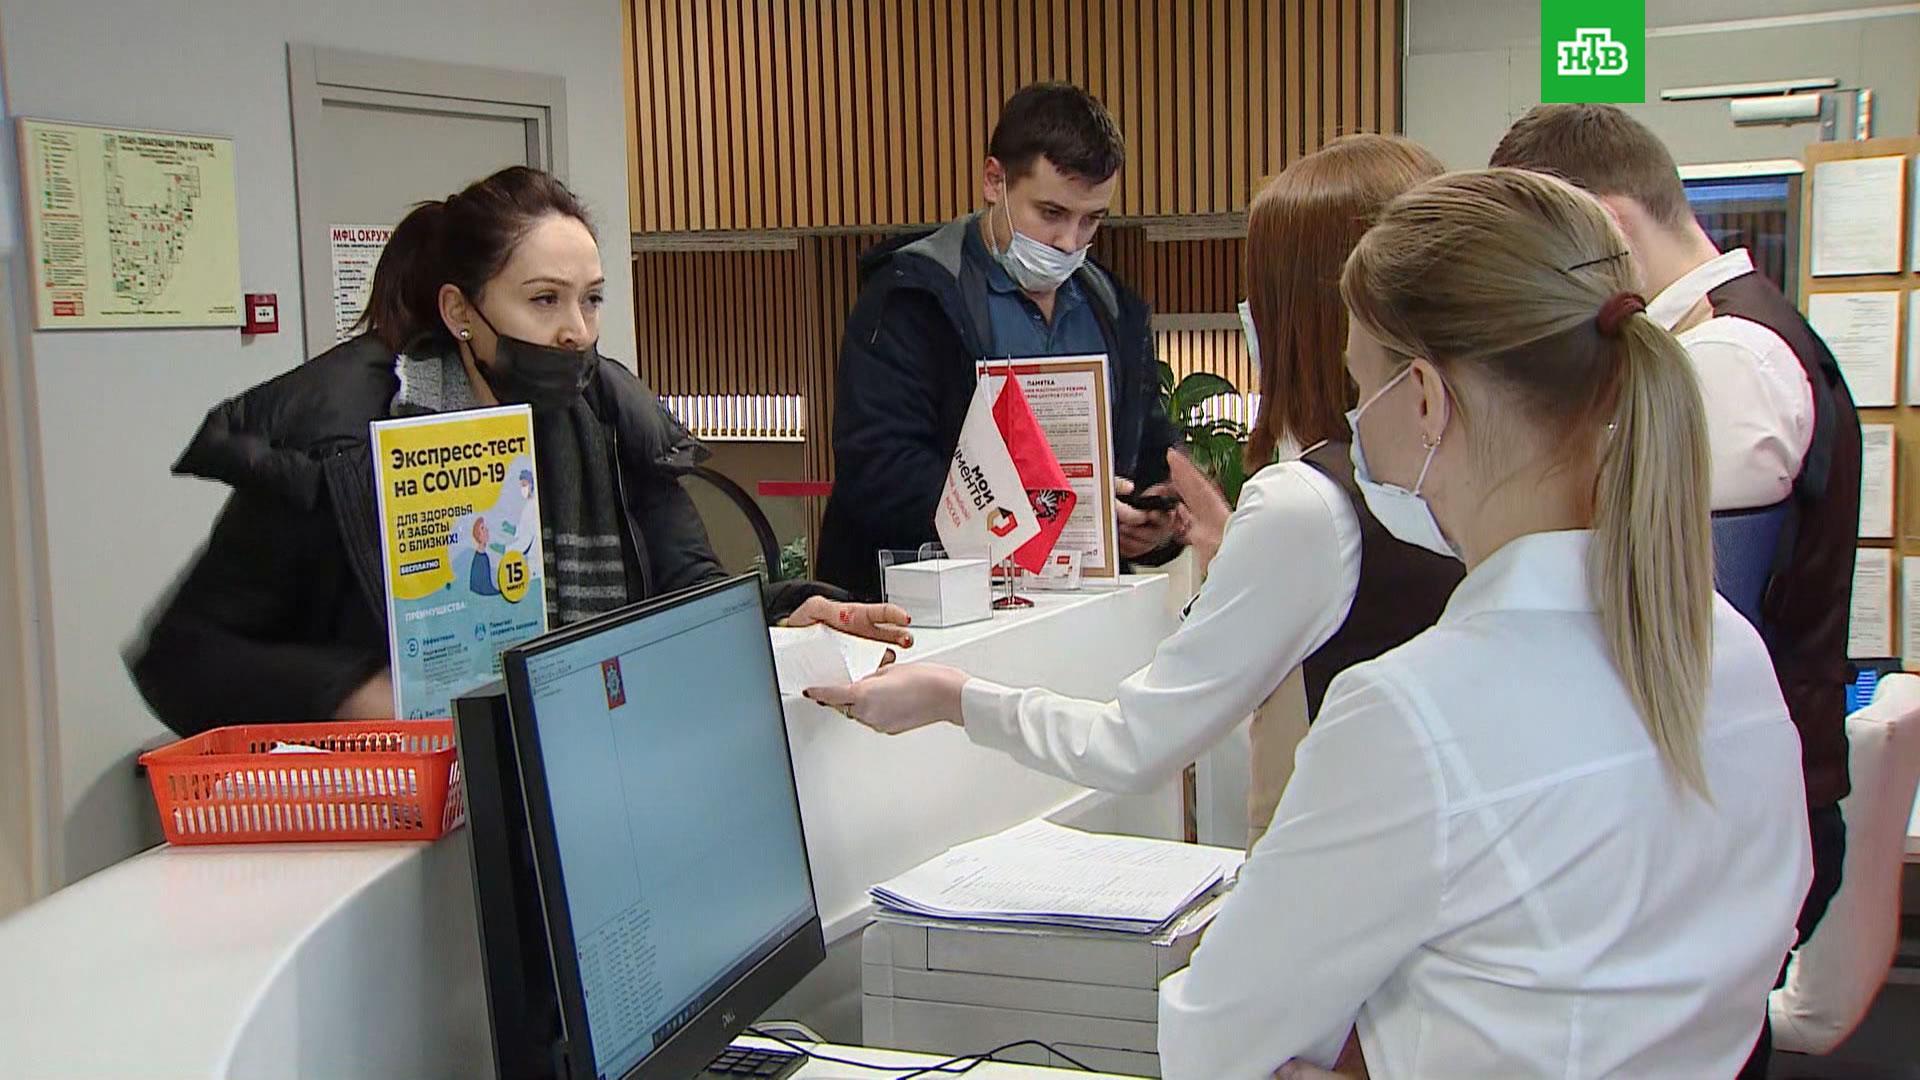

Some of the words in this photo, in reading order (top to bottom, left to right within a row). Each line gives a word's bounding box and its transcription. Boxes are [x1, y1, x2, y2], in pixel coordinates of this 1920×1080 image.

[333, 229, 356, 243] МФЦ
[1026, 379, 1056, 387] ПАМЯТКА
[391, 436, 526, 469] Экспресс-тест
[394, 479, 418, 498] на
[422, 462, 506, 494] COVID-19
[397, 514, 419, 528] ДЛЯ
[420, 504, 473, 523] ЗДОРОВЬЯ
[397, 528, 406, 541] И
[407, 522, 450, 540] ЗАБОТЫ
[399, 543, 406, 554] О
[409, 532, 459, 552] БЛИЗКИХ!
[400, 560, 440, 575] БЕСПЛАТНО
[505, 562, 524, 584] 15
